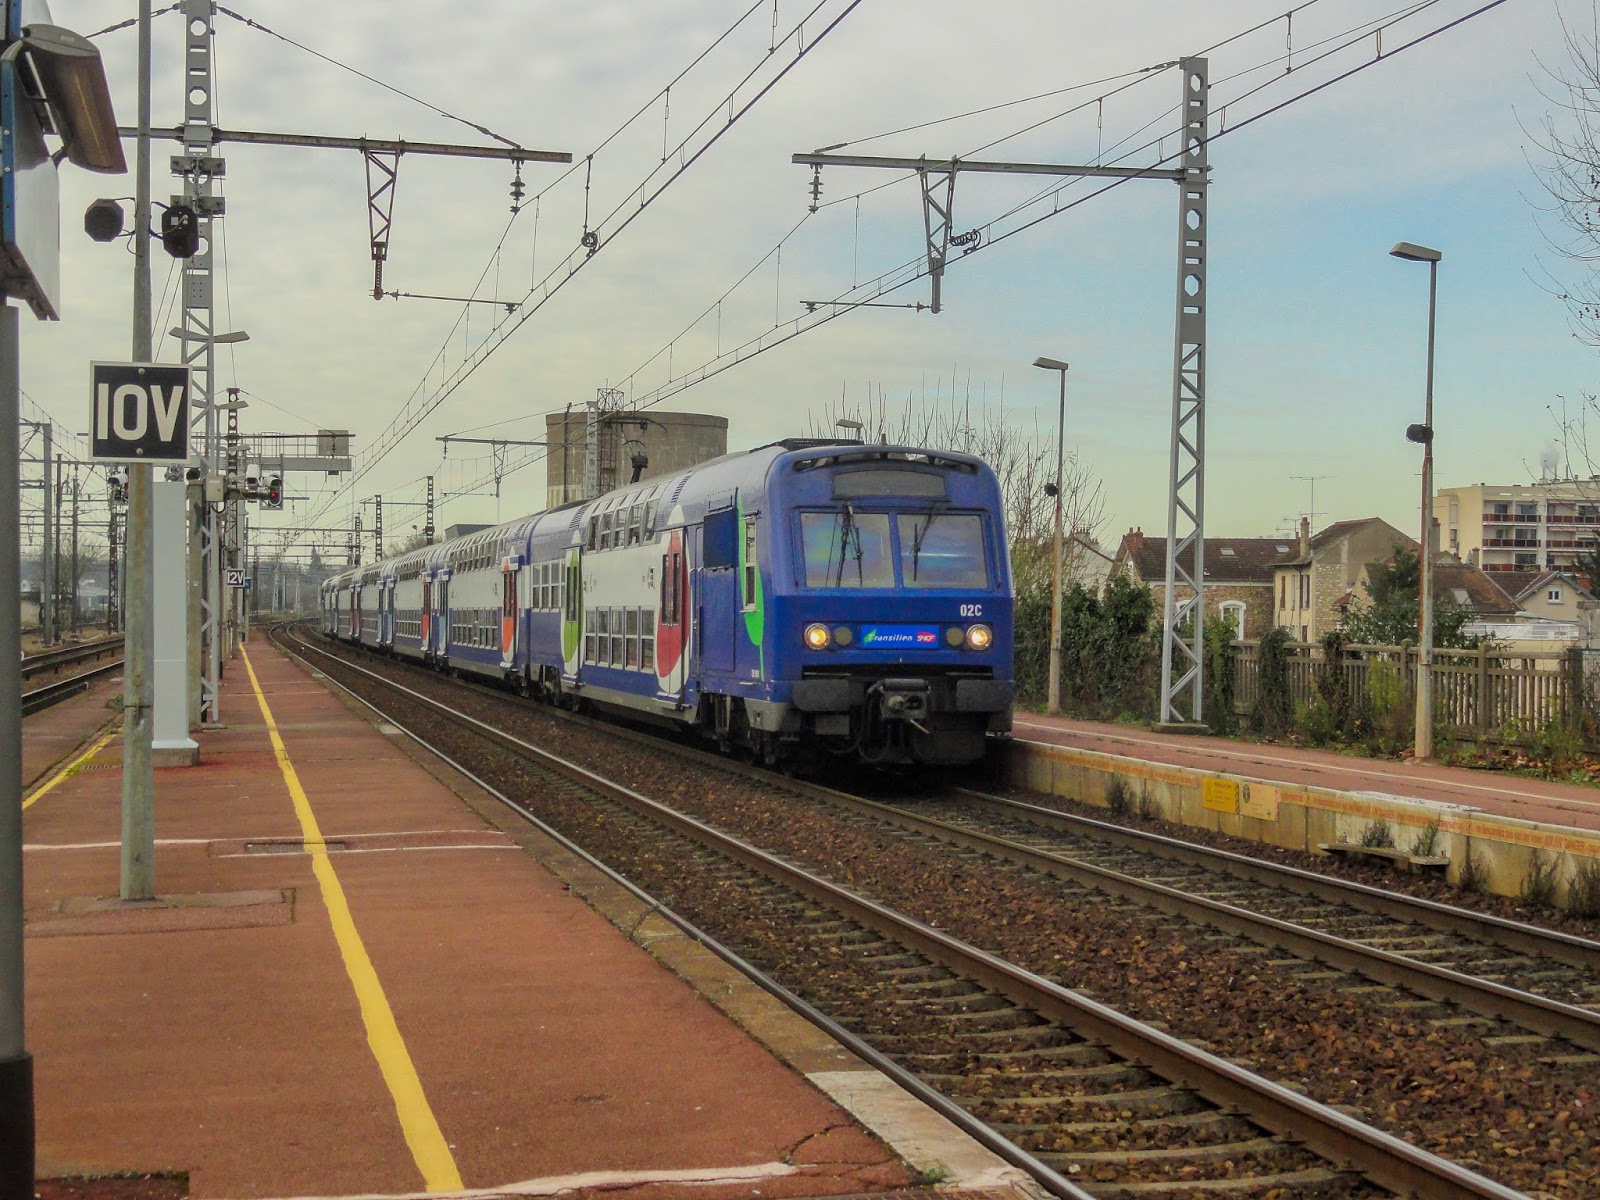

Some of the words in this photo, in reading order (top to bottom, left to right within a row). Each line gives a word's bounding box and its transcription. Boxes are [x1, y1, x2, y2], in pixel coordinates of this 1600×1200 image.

[97, 383, 184, 442] 10V
[227, 571, 244, 584] 12V
[960, 604, 982, 617] 02C
[868, 633, 913, 642] Transilien
[916, 634, 936, 642] SNCF
